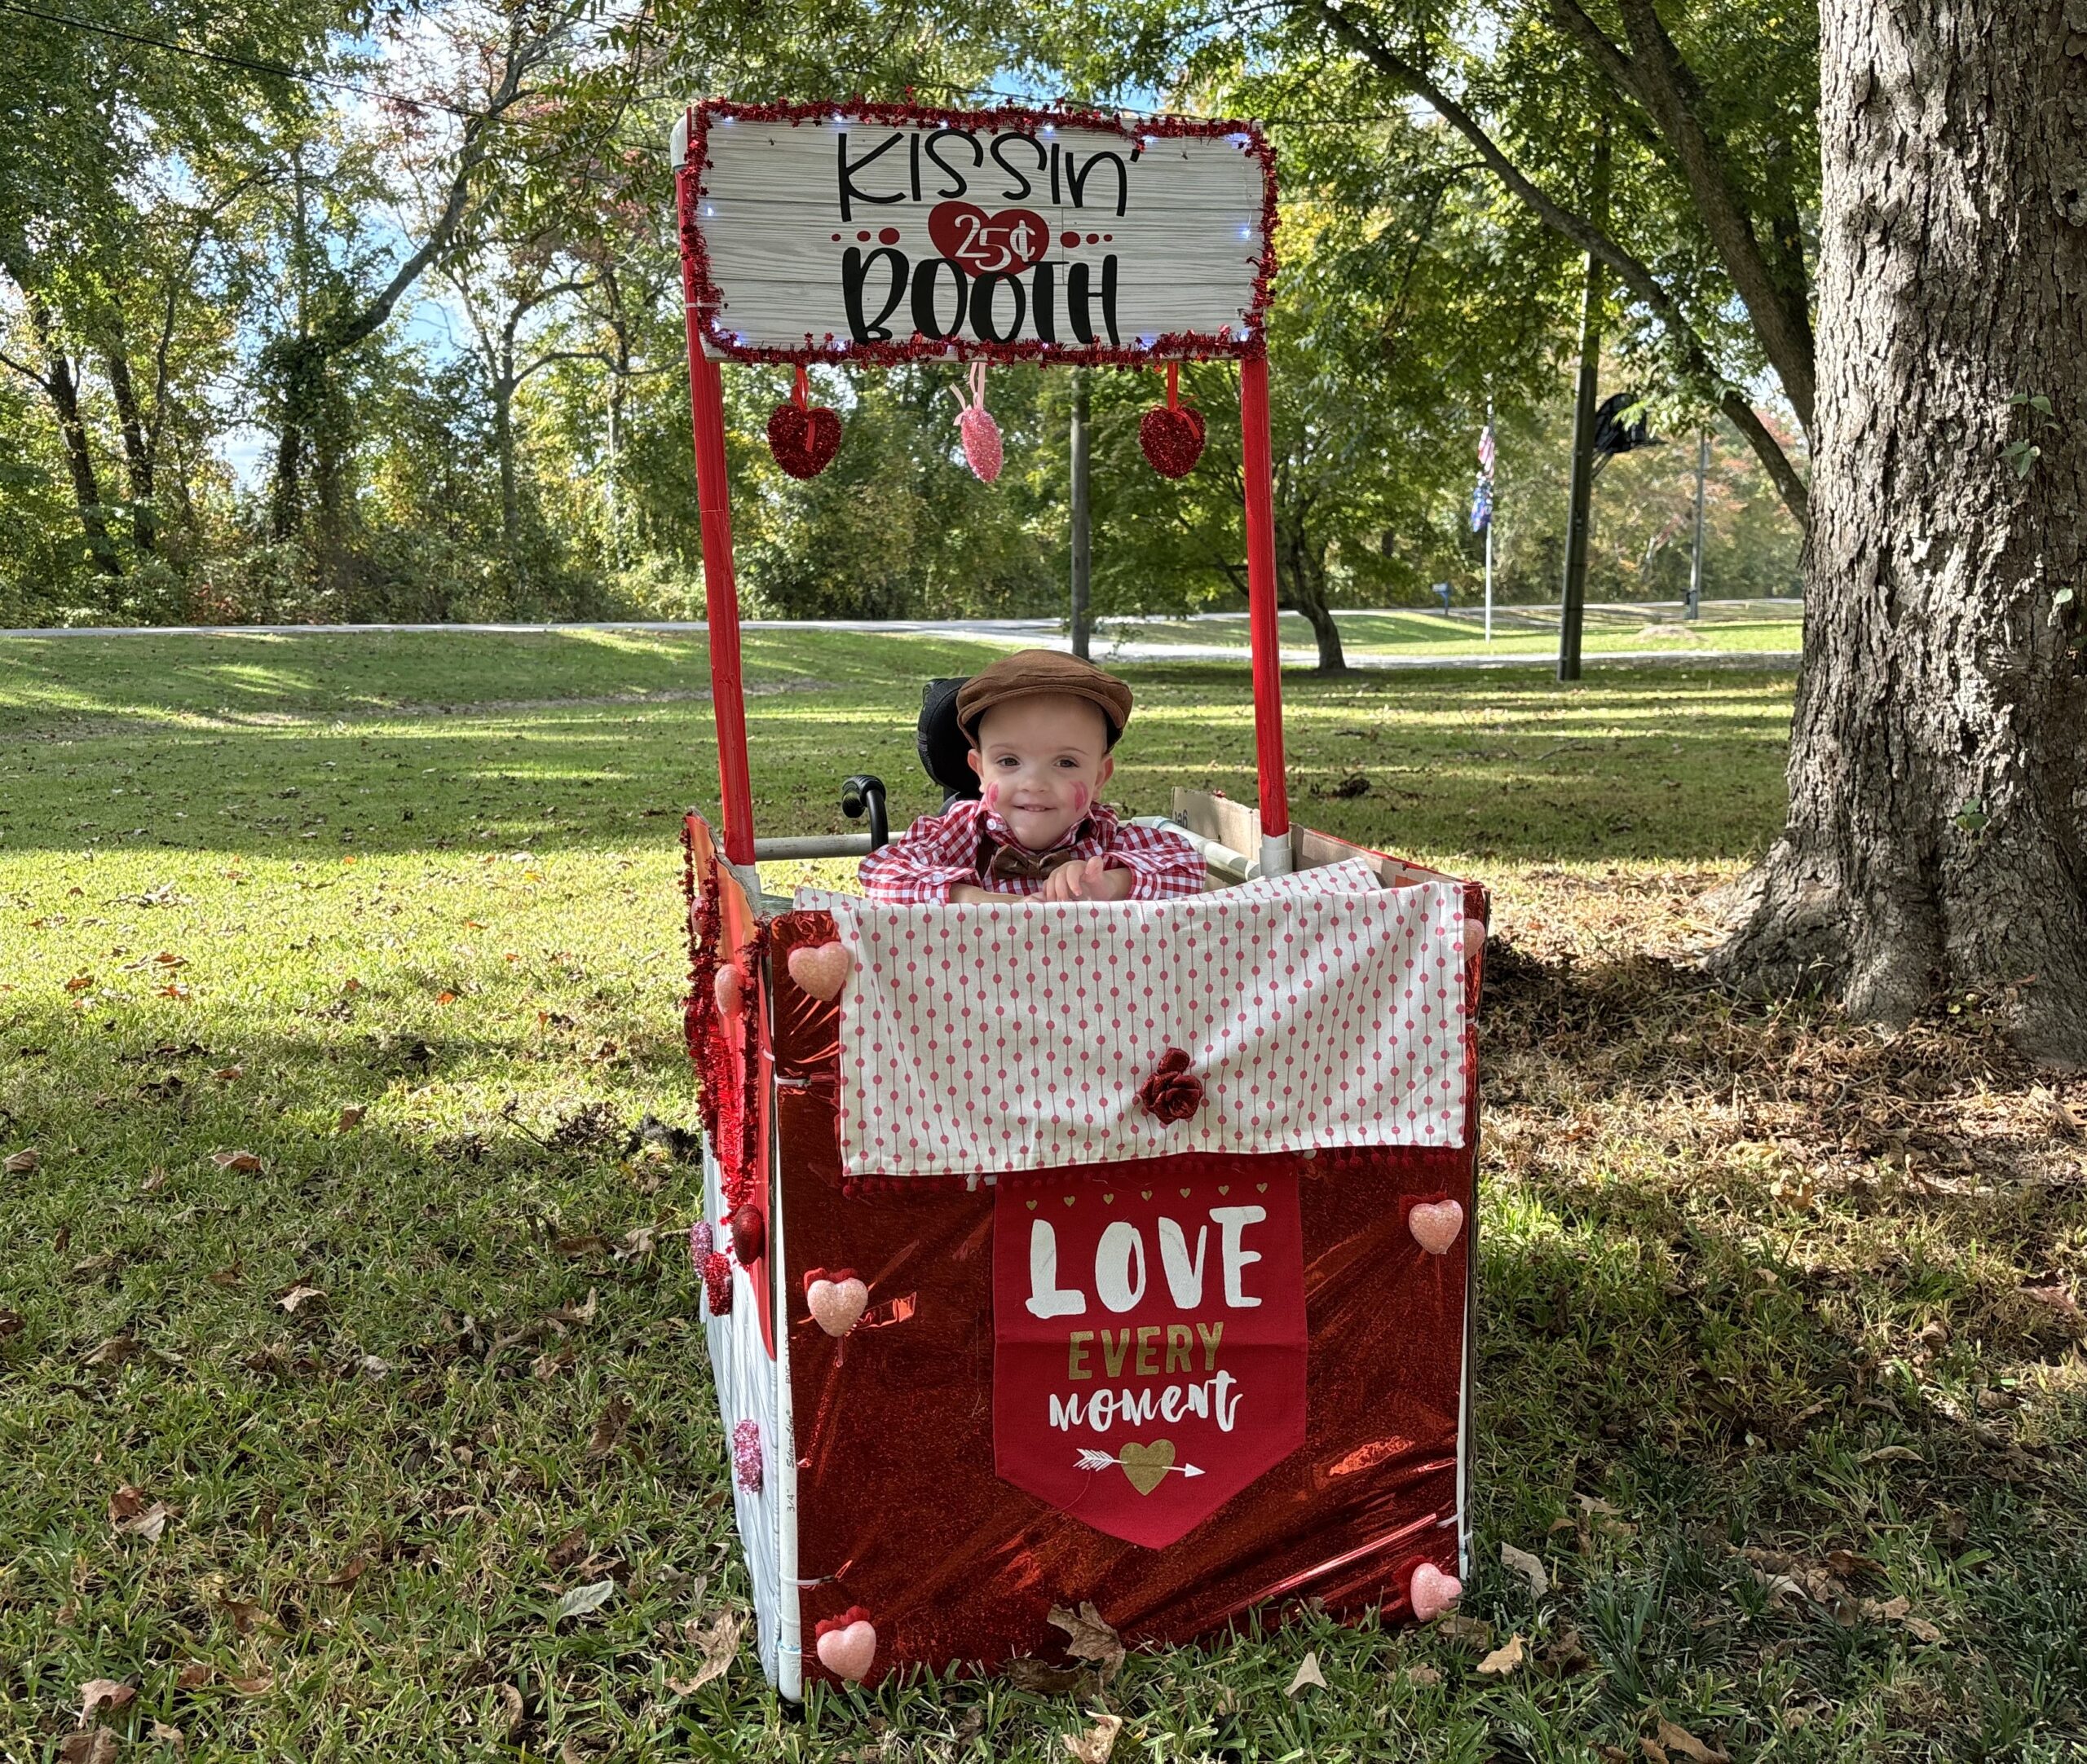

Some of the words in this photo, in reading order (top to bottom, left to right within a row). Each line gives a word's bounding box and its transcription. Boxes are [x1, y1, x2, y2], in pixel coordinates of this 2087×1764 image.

[954, 214, 1036, 272] 25¢
[841, 247, 1120, 346] BOOTH
[1025, 1205, 1267, 1319] LOVE
[1068, 1321, 1224, 1380] EVERY
